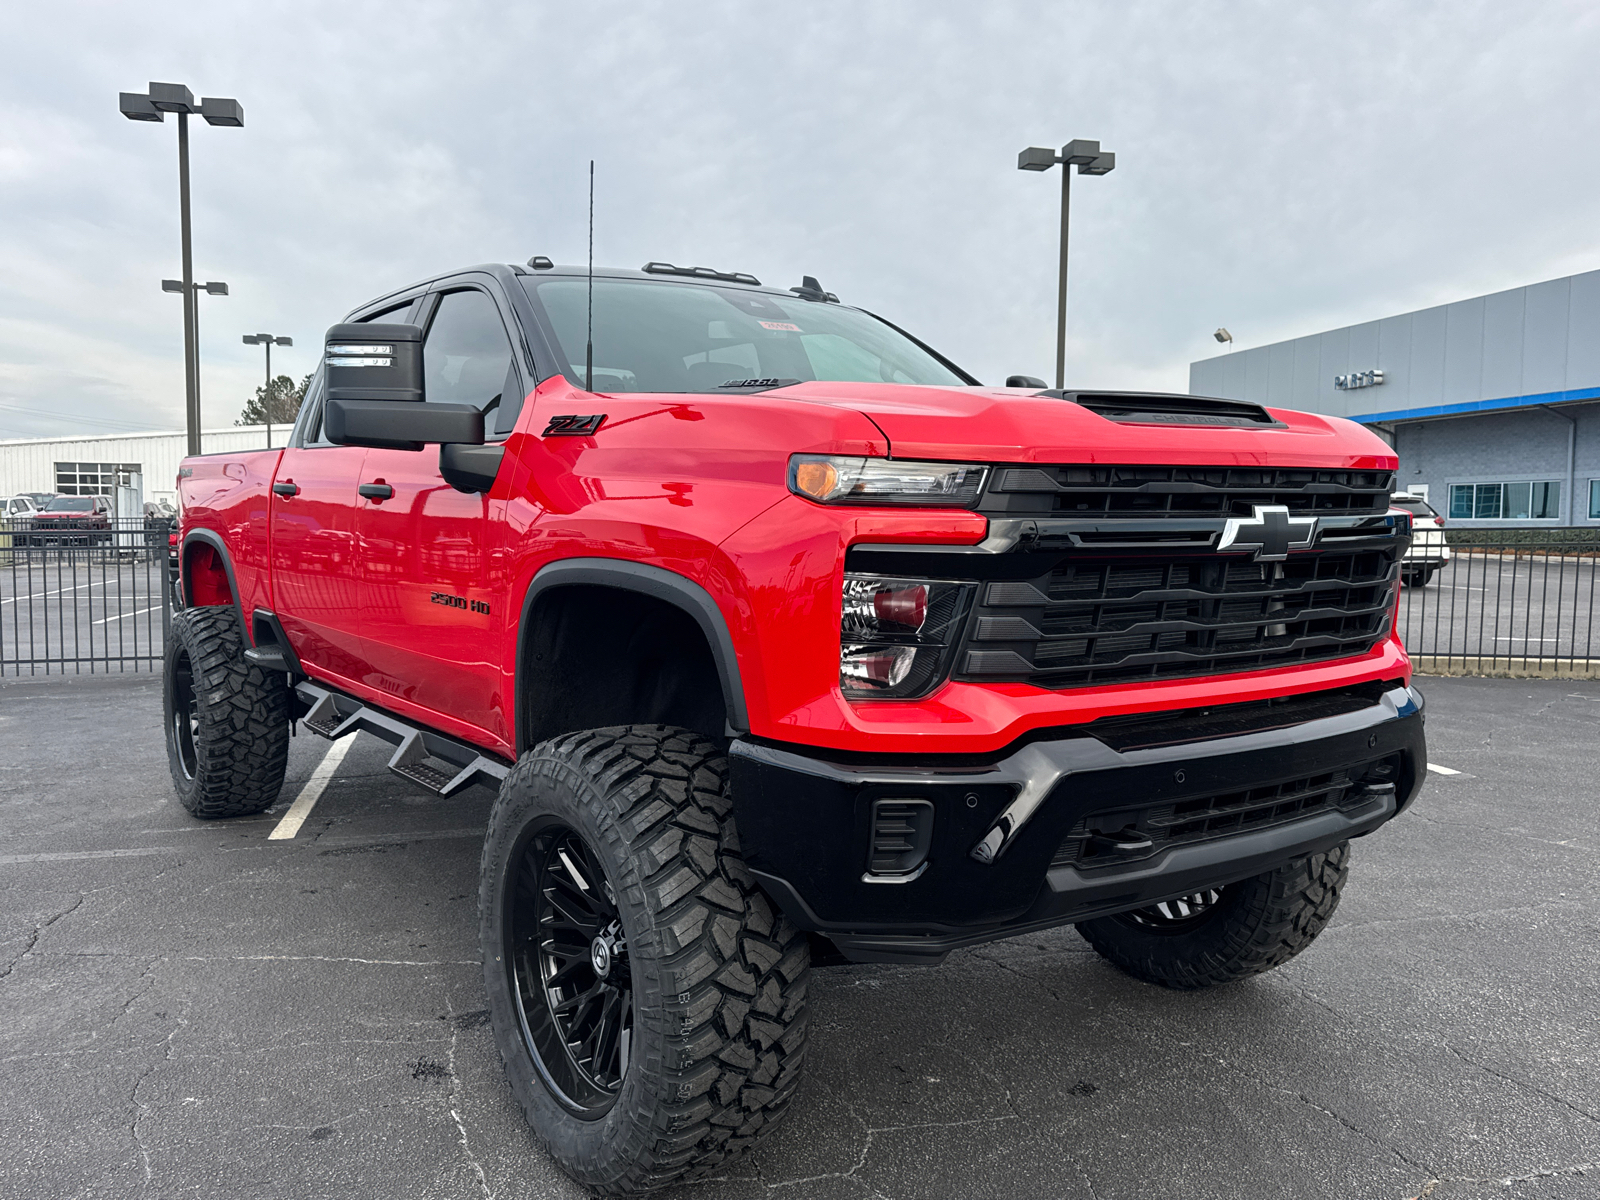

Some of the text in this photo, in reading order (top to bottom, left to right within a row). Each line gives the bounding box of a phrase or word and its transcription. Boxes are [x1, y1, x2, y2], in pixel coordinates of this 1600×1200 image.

[1334, 369, 1381, 390] PARTS
[541, 414, 608, 437] Z71
[1152, 414, 1243, 426] CHEVROLET
[430, 590, 490, 615] 2500 HD
